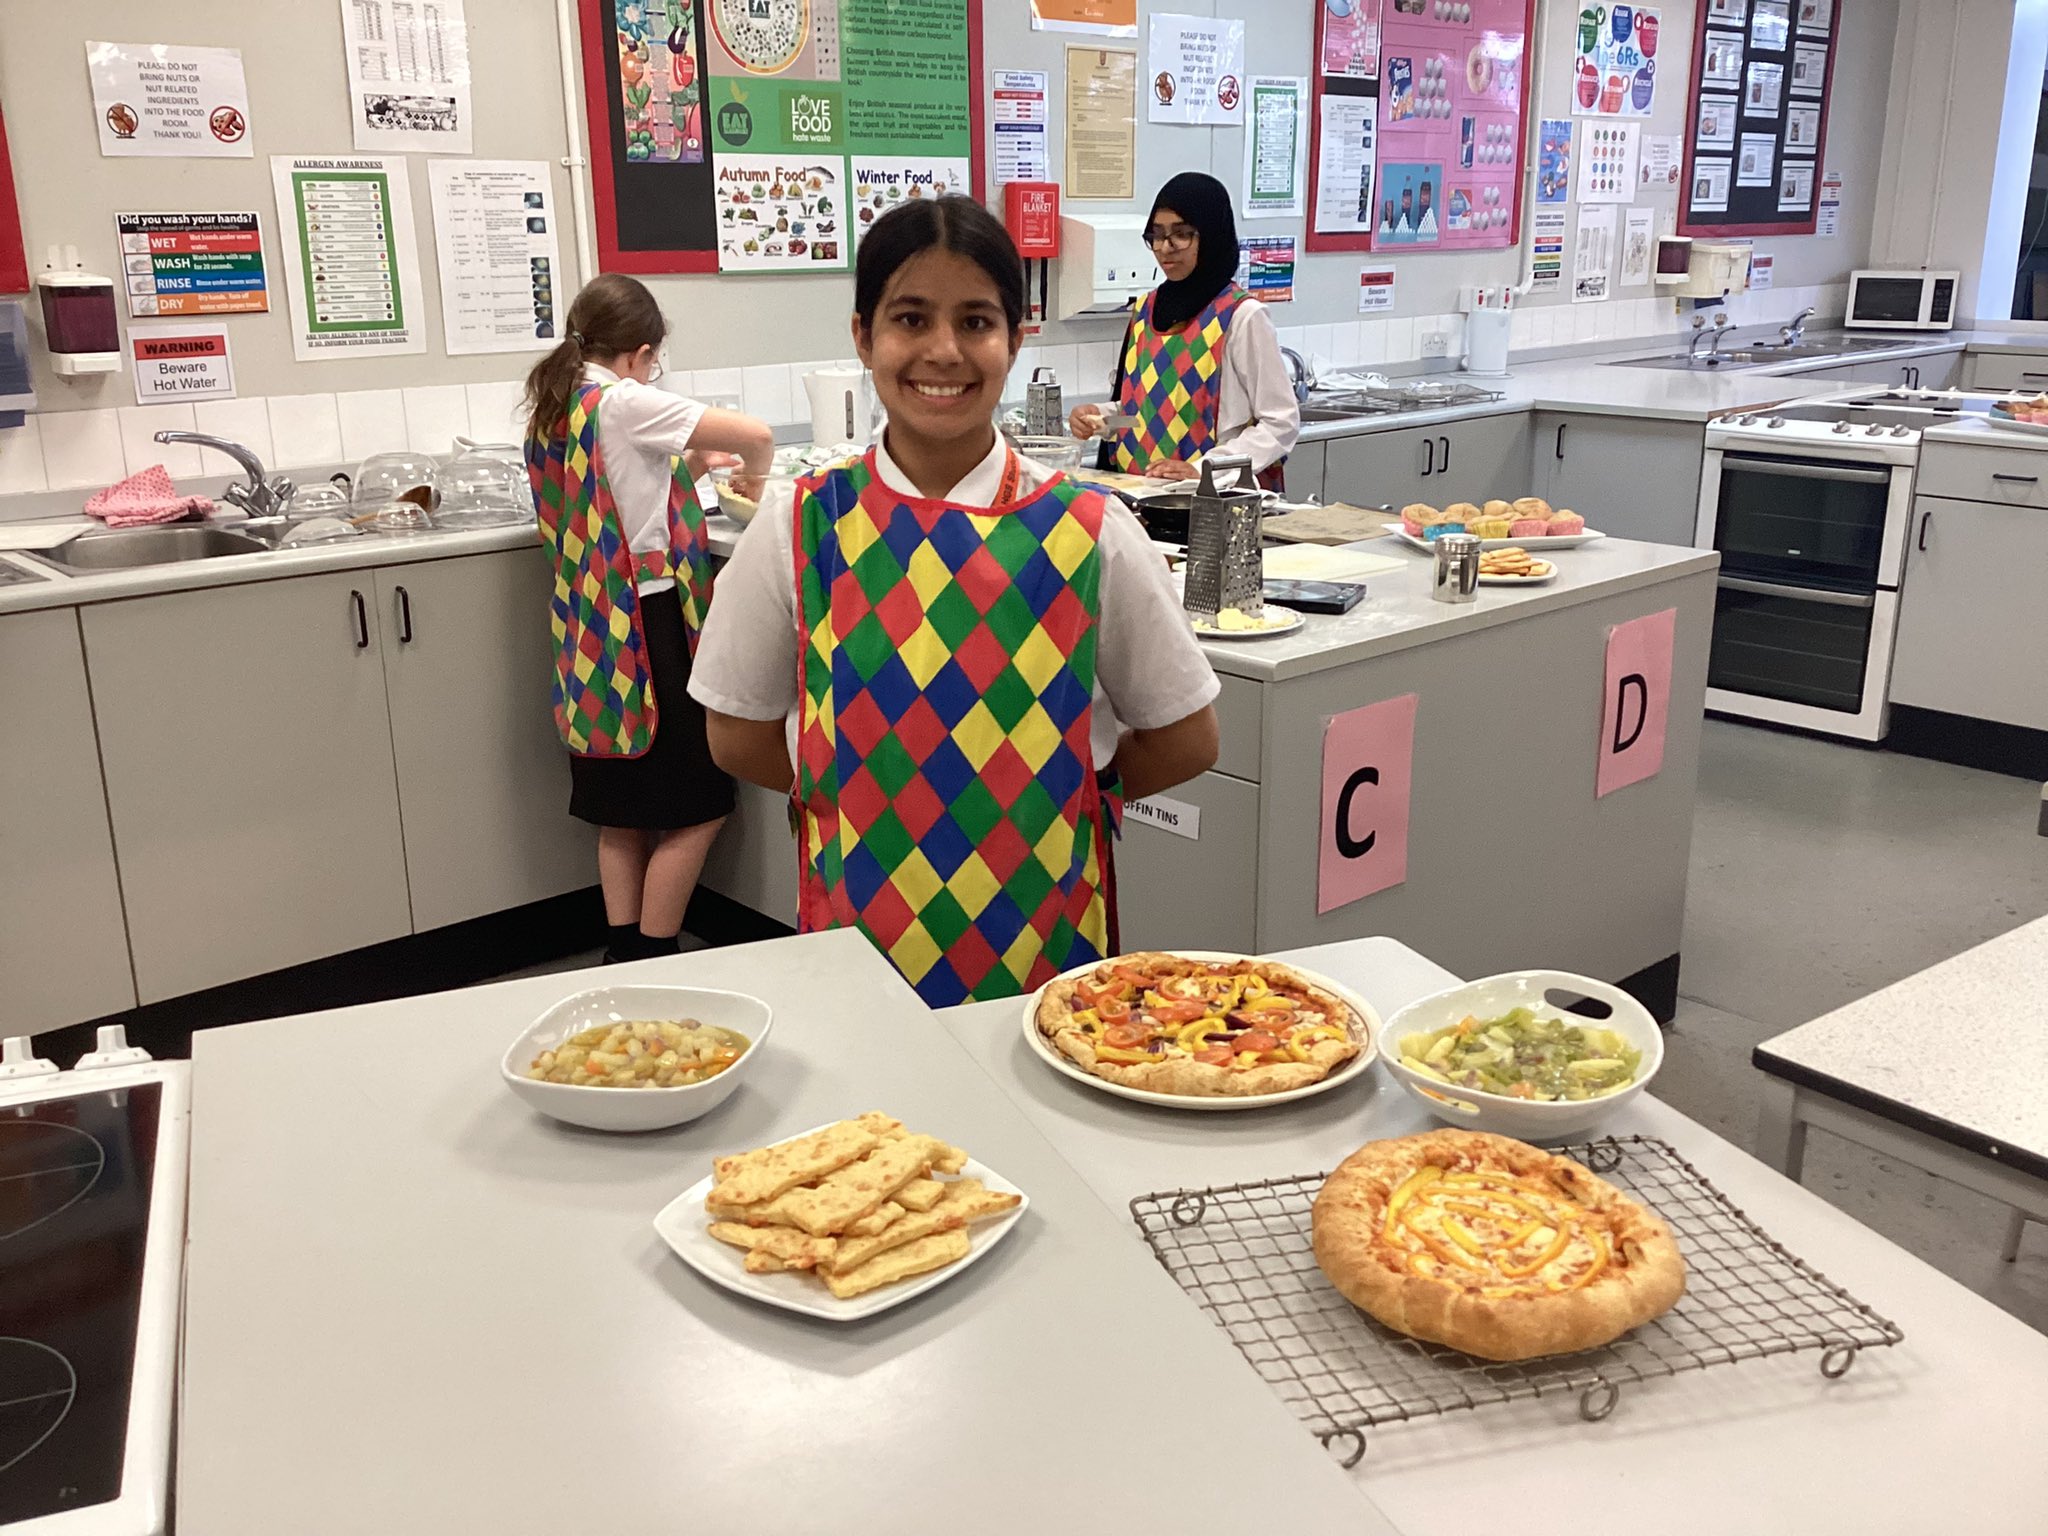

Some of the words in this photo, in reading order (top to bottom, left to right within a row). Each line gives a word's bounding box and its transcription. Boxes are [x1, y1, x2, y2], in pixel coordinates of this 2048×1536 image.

[1617, 46, 1639, 66] 6Rs
[168, 62, 180, 70] DO
[166, 74, 187, 82] NUTS
[164, 85, 197, 93] RELATED
[148, 97, 199, 105] INGREDIENTS
[791, 97, 830, 115] LOVE
[849, 99, 864, 109] Enjoy
[166, 108, 180, 116] THE
[182, 108, 205, 116] FOOD
[792, 116, 831, 132] FOOD
[154, 130, 180, 138] THANK
[182, 131, 201, 139] YOU!
[294, 160, 335, 168] ALLERGEN
[336, 160, 383, 169] AWARENESS
[720, 166, 770, 182] Autumn
[776, 167, 807, 182] Food
[856, 169, 900, 184] Winter
[904, 169, 932, 184] Food
[1030, 193, 1044, 203] FIRE
[1023, 203, 1051, 212] BLANKET
[120, 215, 139, 224] Did
[142, 217, 161, 226] you
[163, 214, 190, 224] wash
[192, 216, 216, 226] your
[217, 214, 253, 224] hands?
[151, 238, 176, 248] WET
[154, 258, 190, 269] WASH
[157, 278, 192, 289] RINSE
[160, 299, 184, 310] DRY
[145, 341, 214, 354] WARNING
[159, 363, 207, 374] Beware
[154, 380, 177, 391] Hot
[180, 378, 216, 389] Water
[1613, 674, 1648, 754] D
[1156, 808, 1178, 826] TINS
[1335, 766, 1378, 859] C
